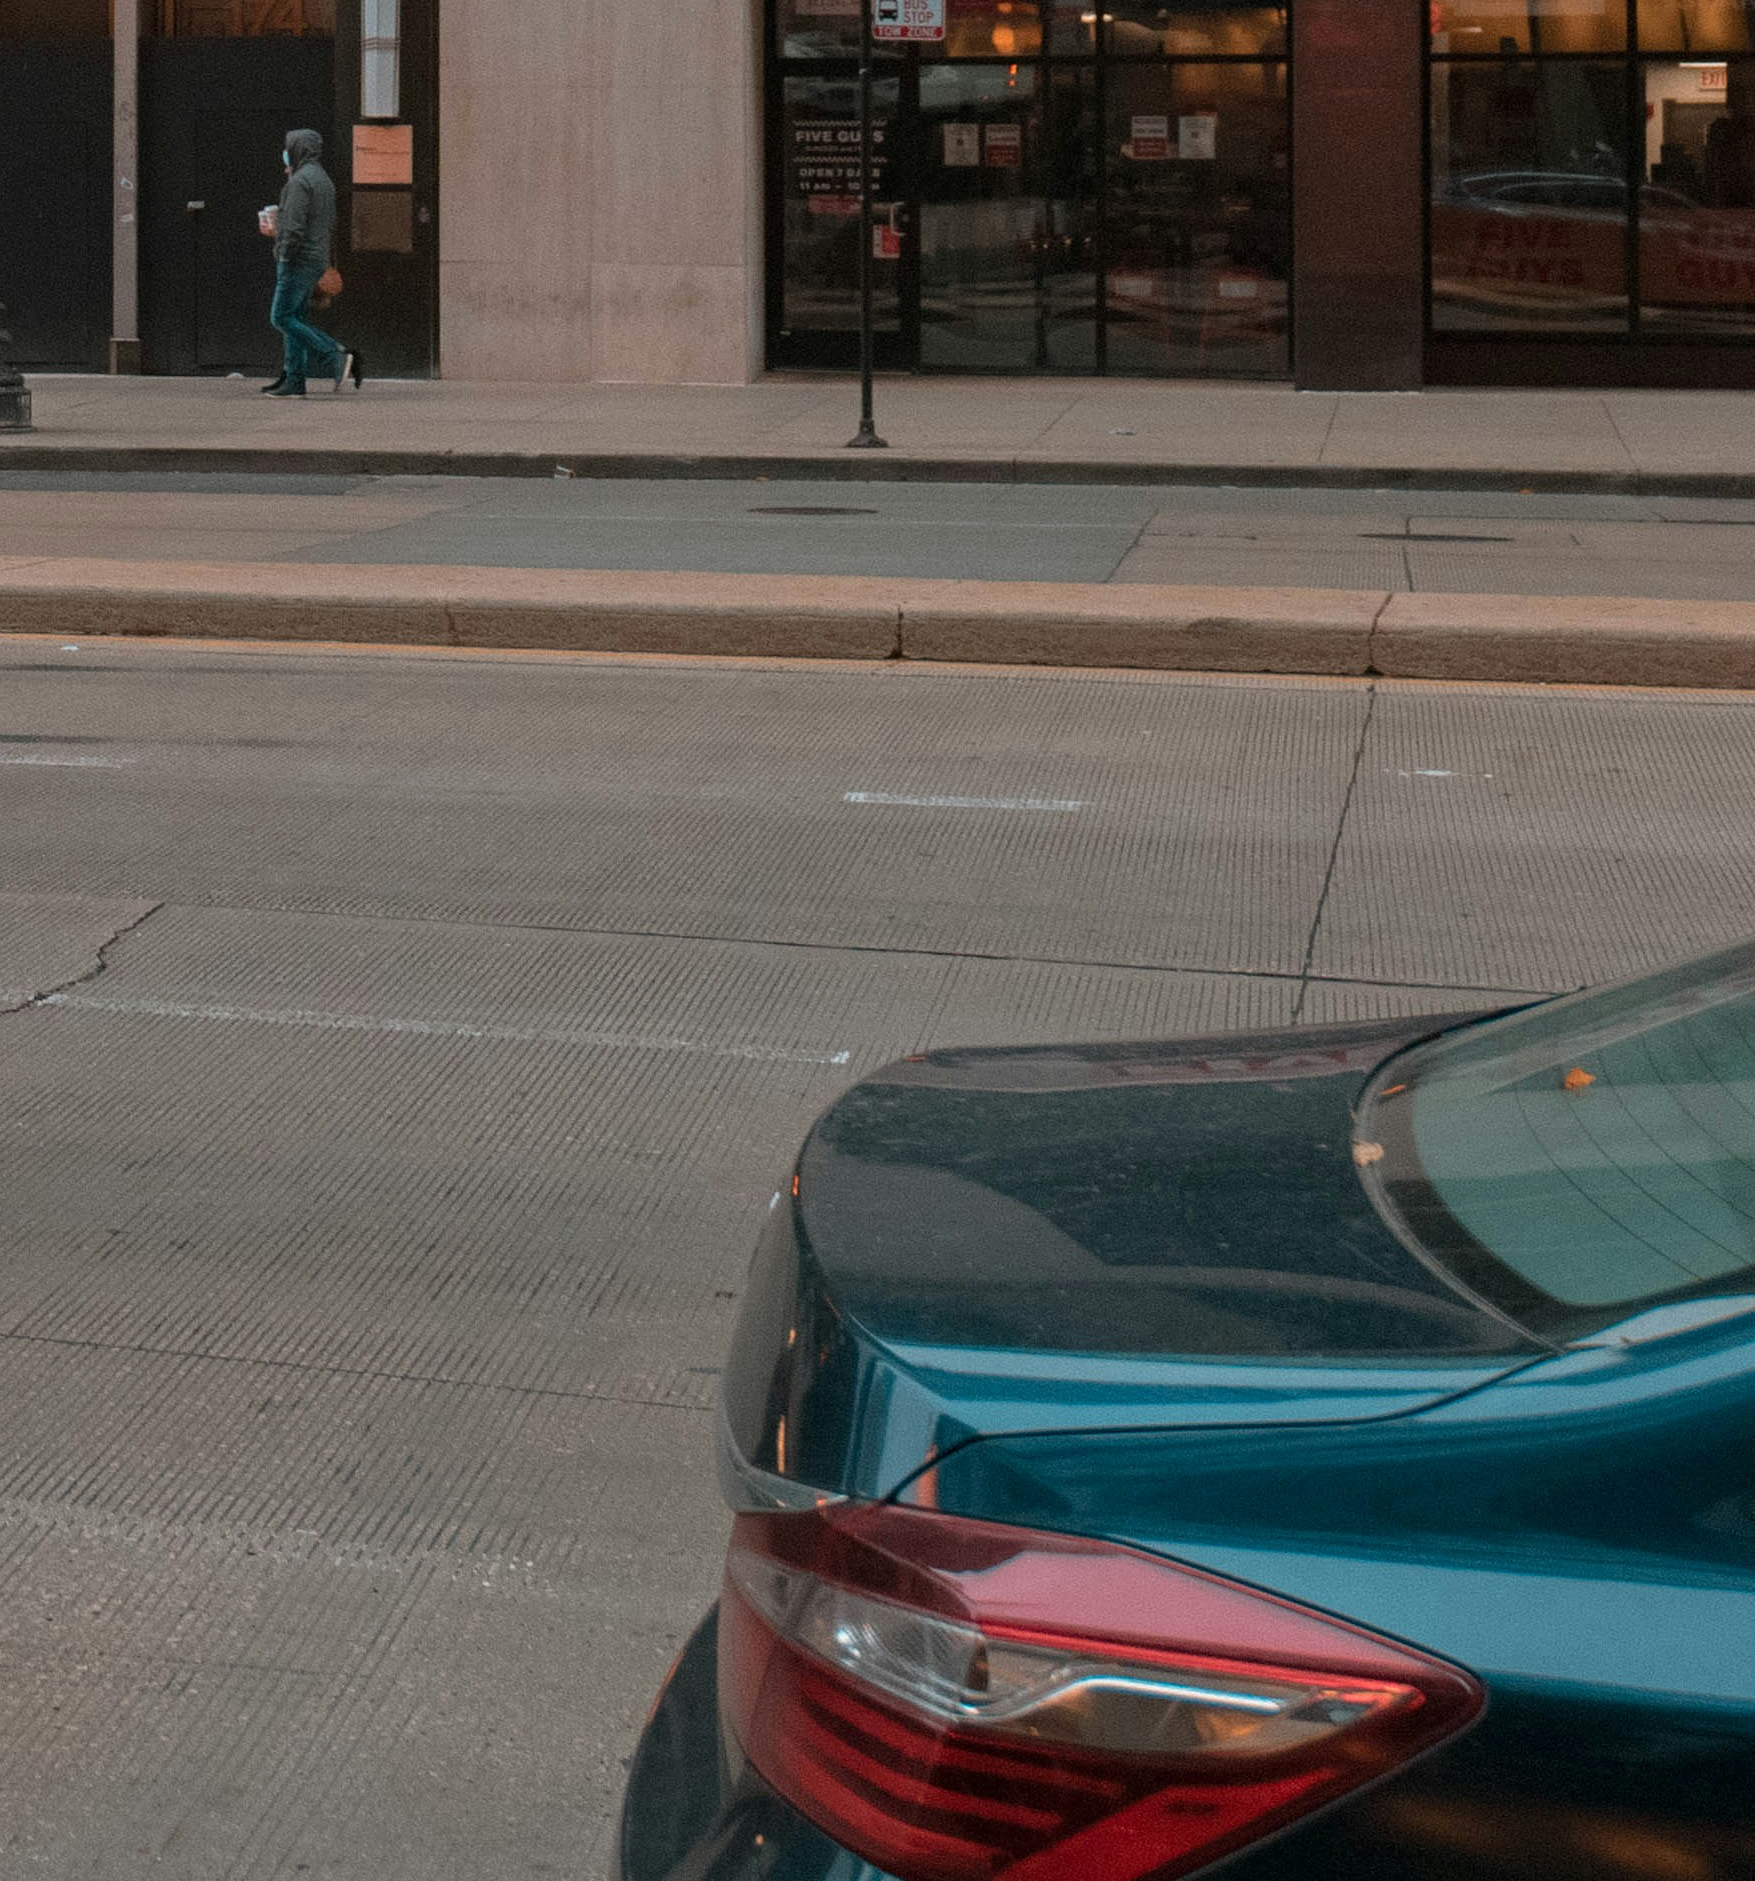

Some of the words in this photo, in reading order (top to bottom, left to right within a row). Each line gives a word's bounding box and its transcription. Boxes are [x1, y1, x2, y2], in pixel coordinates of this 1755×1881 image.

[903, 11, 935, 24] STOP
[877, 26, 902, 37] TOW
[906, 26, 937, 37] ZONE
[795, 130, 832, 143] FIVE
[837, 130, 885, 144] GUS
[845, 168, 881, 178] DAS
